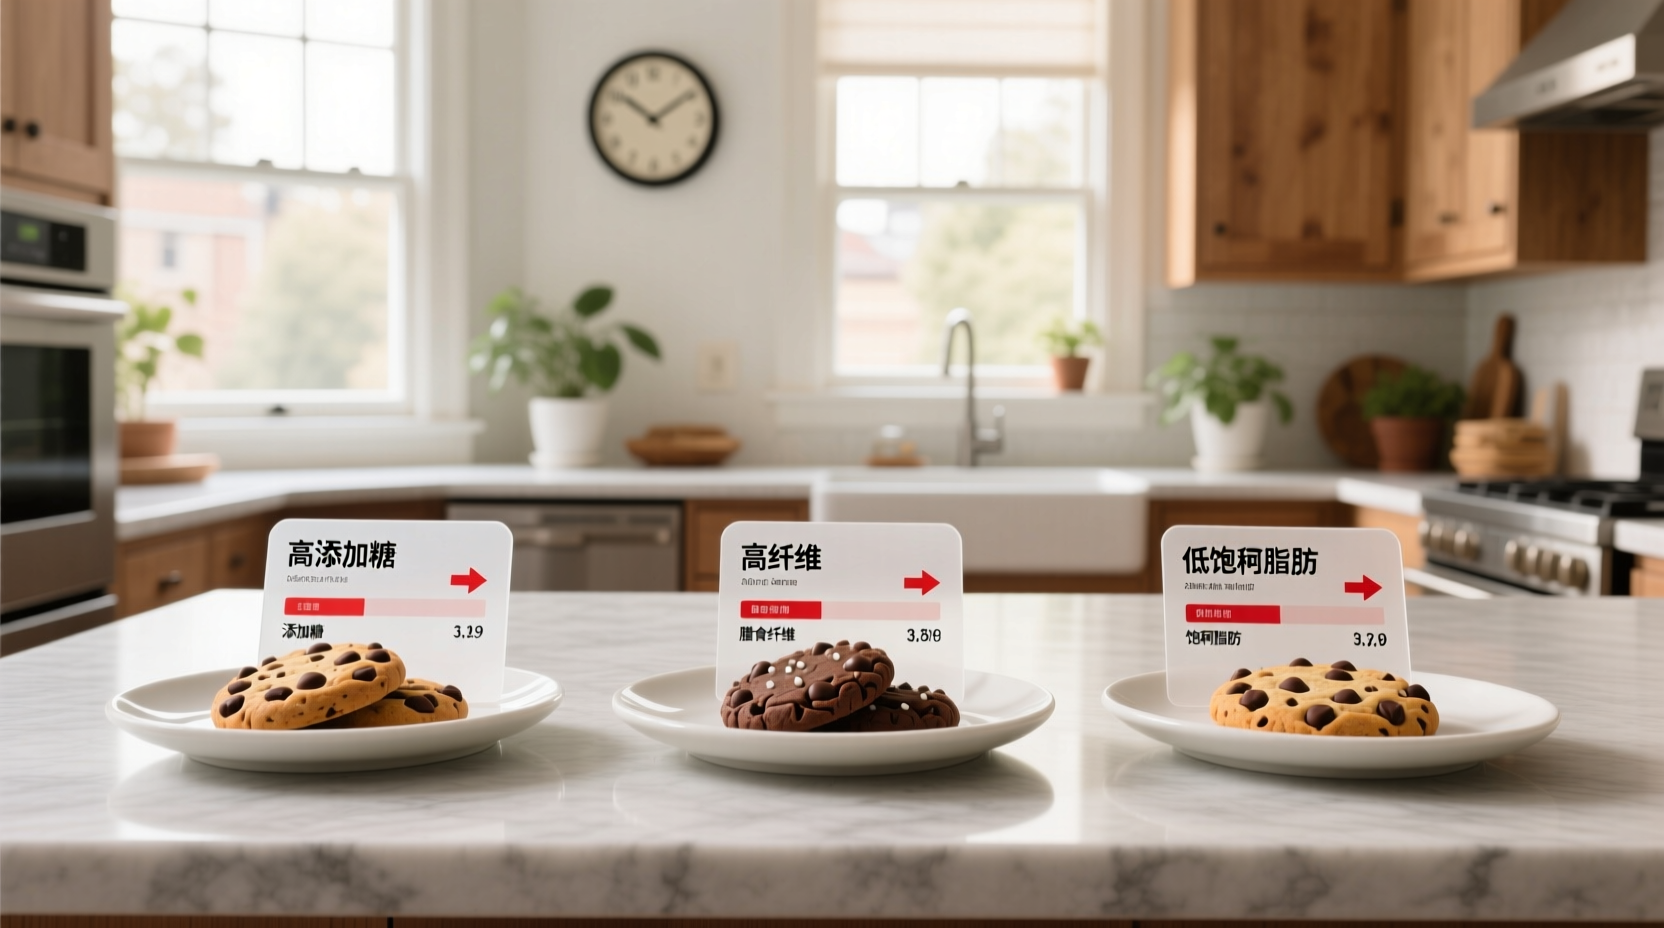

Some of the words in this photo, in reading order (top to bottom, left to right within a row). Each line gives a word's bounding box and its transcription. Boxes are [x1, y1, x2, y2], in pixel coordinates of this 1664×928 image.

[288, 539, 397, 569] 高添加糖
[741, 542, 822, 571] 高纤维
